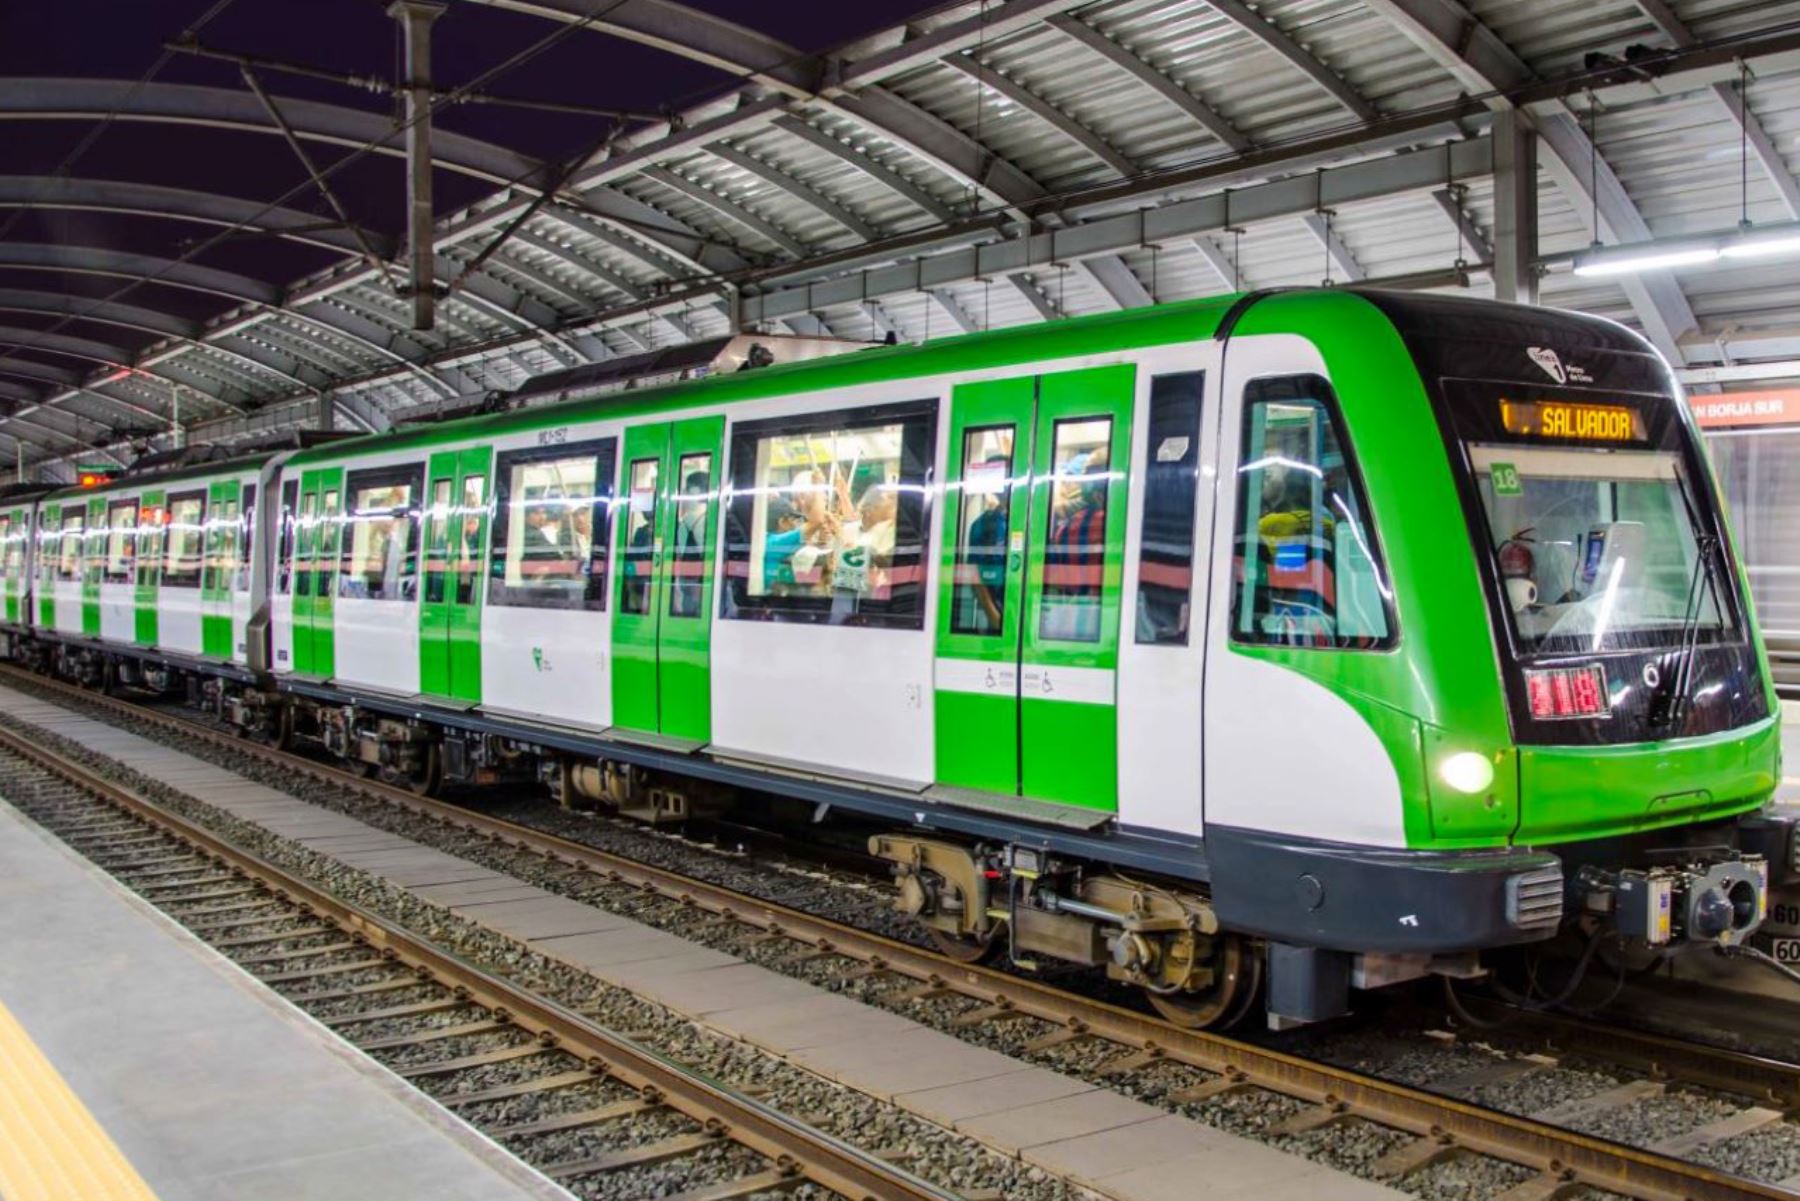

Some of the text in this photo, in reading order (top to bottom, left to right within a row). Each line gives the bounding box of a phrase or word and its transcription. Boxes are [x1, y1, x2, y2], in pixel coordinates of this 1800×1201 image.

[1707, 402, 1753, 418] BORJA
[1754, 399, 1784, 415] SUR
[1542, 407, 1631, 440] SALVADOR
[1494, 468, 1518, 489] 18
